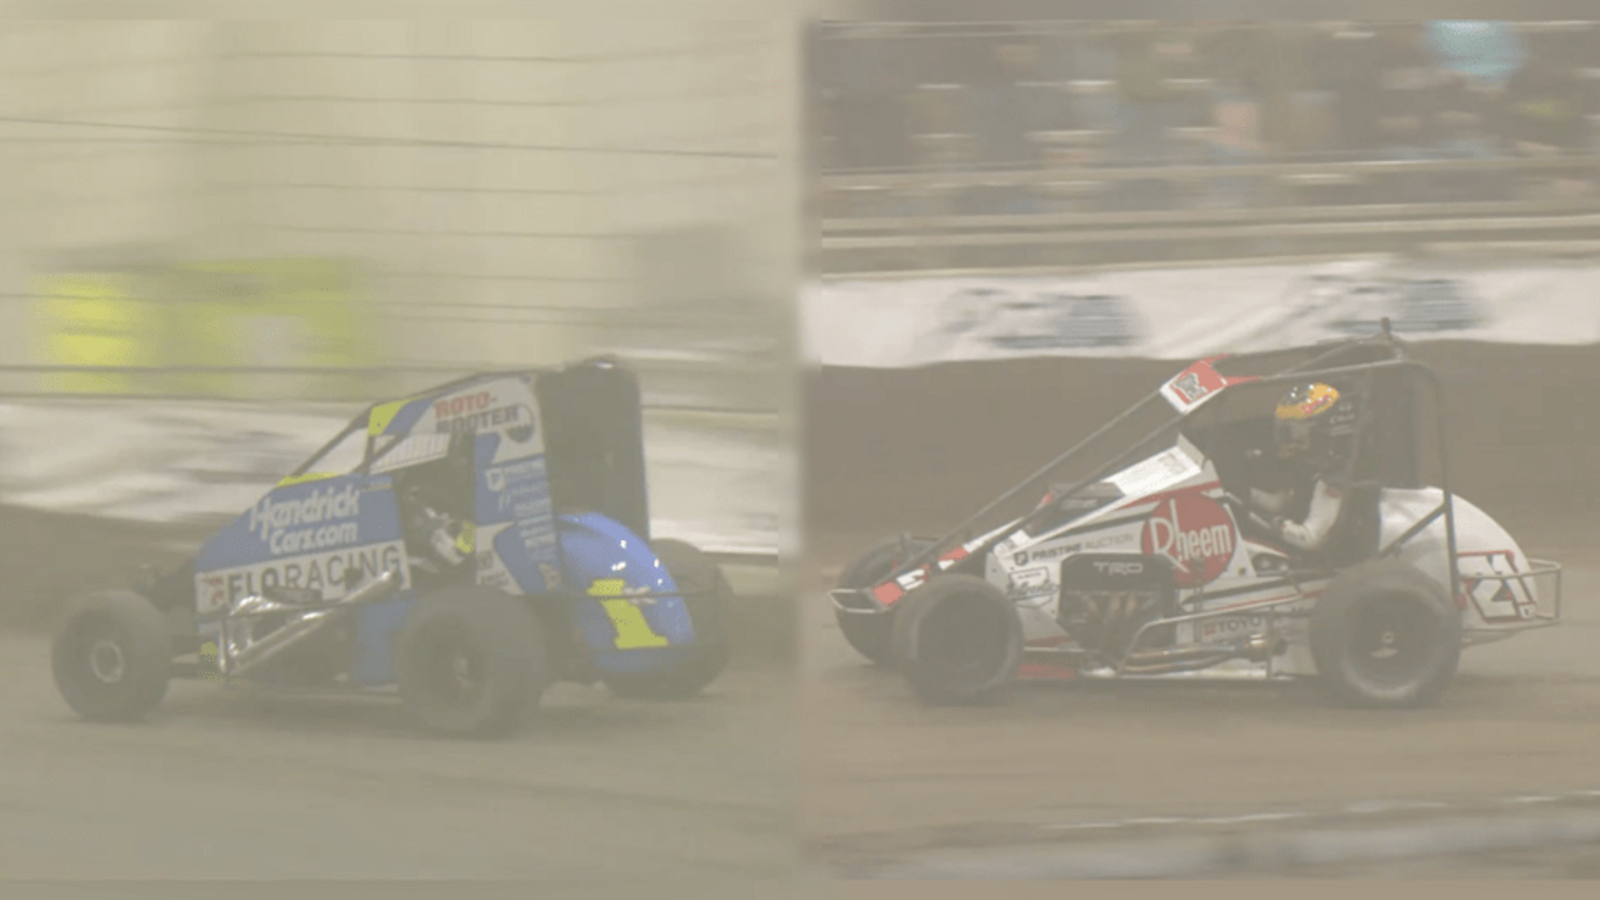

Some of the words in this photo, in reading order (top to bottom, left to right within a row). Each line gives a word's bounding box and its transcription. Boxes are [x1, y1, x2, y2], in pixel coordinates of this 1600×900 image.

[436, 405, 519, 433] ROOTER
[249, 484, 360, 540] Hendrick
[270, 522, 358, 555] Cars.com
[1031, 543, 1083, 560] PRISTINE
[1085, 533, 1135, 551] AUCTION
[1148, 498, 1233, 573] Rheem
[1093, 561, 1144, 576] TRD
[586, 578, 669, 650] 1
[1219, 612, 1268, 633] TOYO
